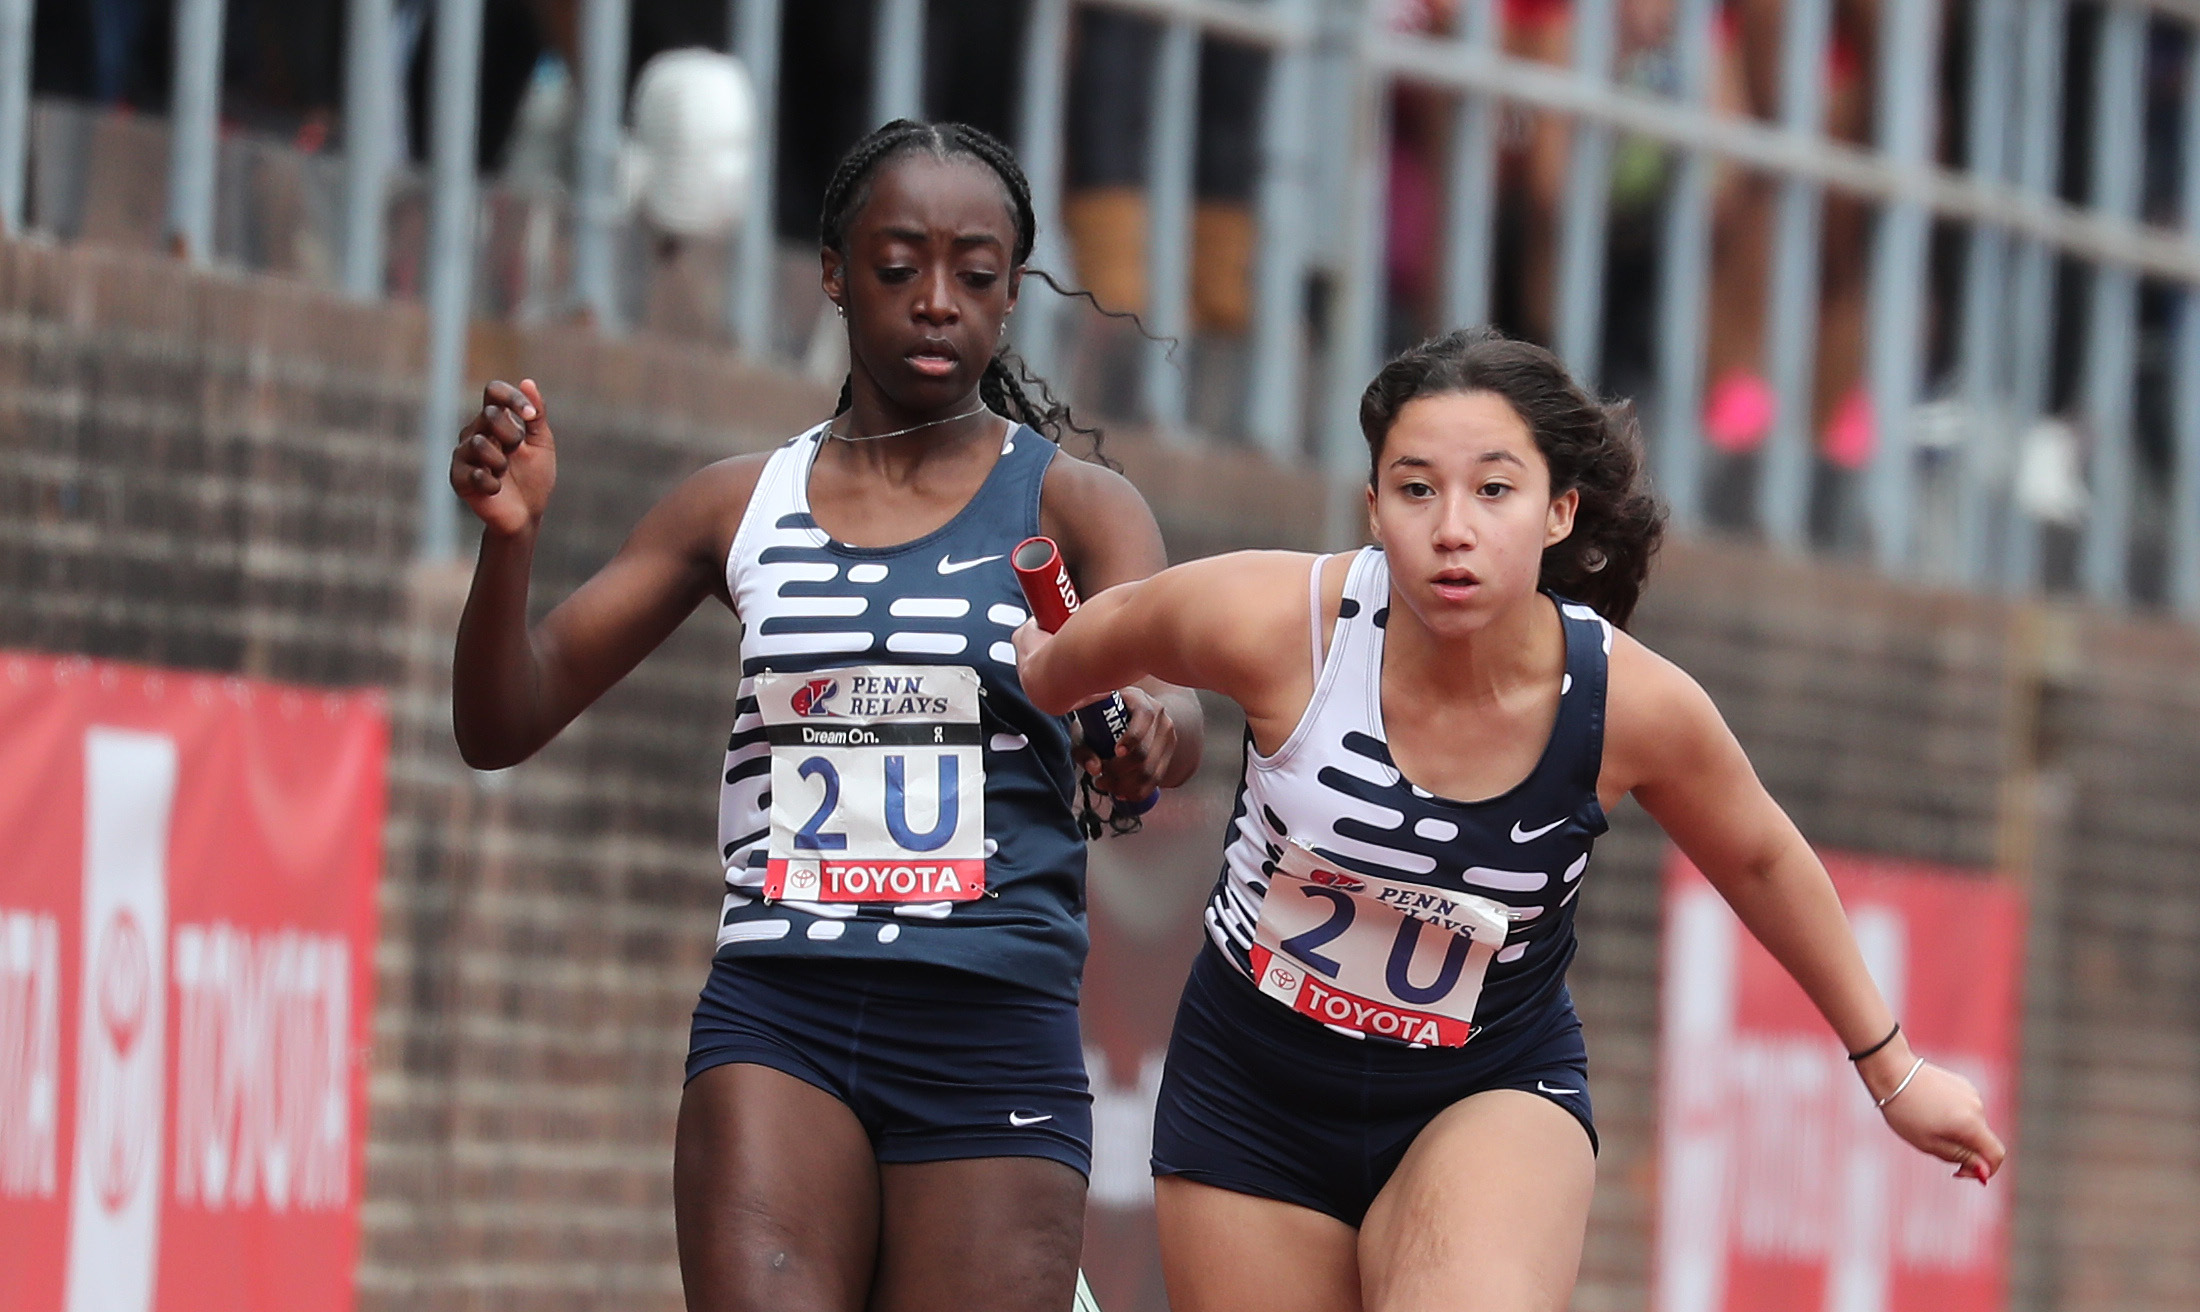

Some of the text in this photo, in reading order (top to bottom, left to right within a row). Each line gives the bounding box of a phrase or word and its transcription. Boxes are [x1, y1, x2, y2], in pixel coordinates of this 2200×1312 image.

[852, 676, 924, 695] PENN
[850, 697, 949, 716] RELAYS
[802, 727, 880, 744] Dream On.
[794, 755, 960, 852] 2 U
[826, 867, 962, 894] TOYOTA
[1376, 887, 1459, 916] PENN
[1280, 885, 1474, 1005] 2 U
[1308, 984, 1440, 1047] TOYOTA
